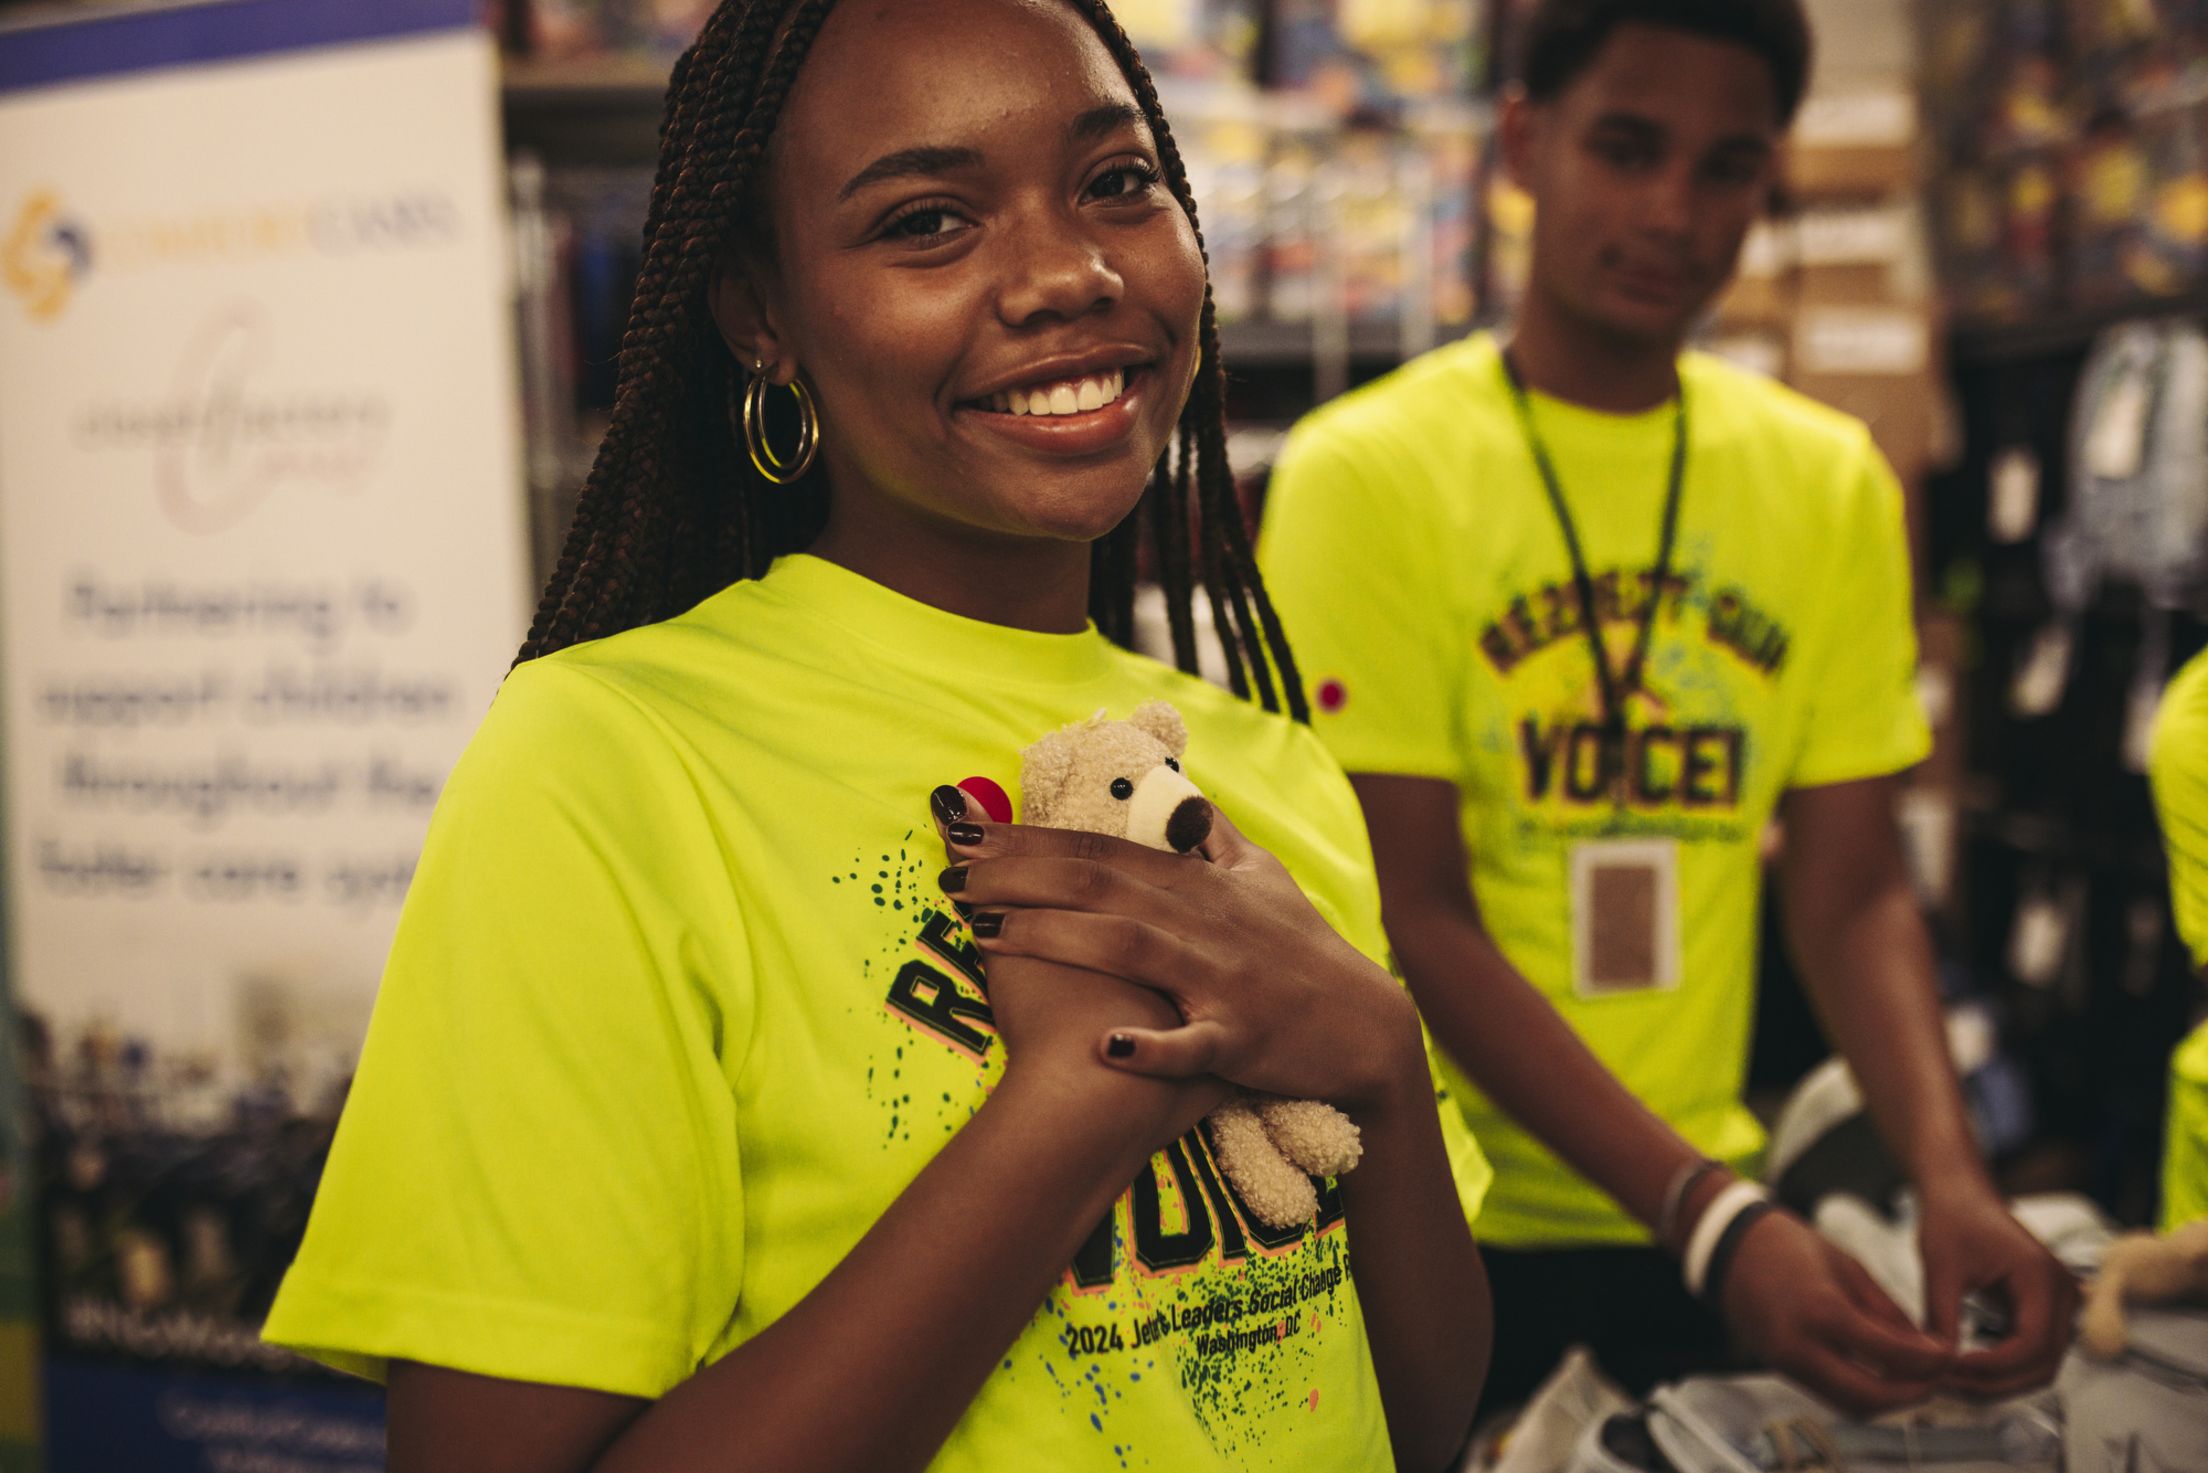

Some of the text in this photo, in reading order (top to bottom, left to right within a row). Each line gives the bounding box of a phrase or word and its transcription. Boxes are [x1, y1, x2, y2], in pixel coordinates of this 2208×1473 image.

[1067, 1322, 1123, 1355] 2024
[1171, 1298, 1243, 1332] Leaders
[1249, 1275, 1298, 1315] Social
[1301, 1265, 1342, 1300] Change
[1285, 1309, 1301, 1339] DC
